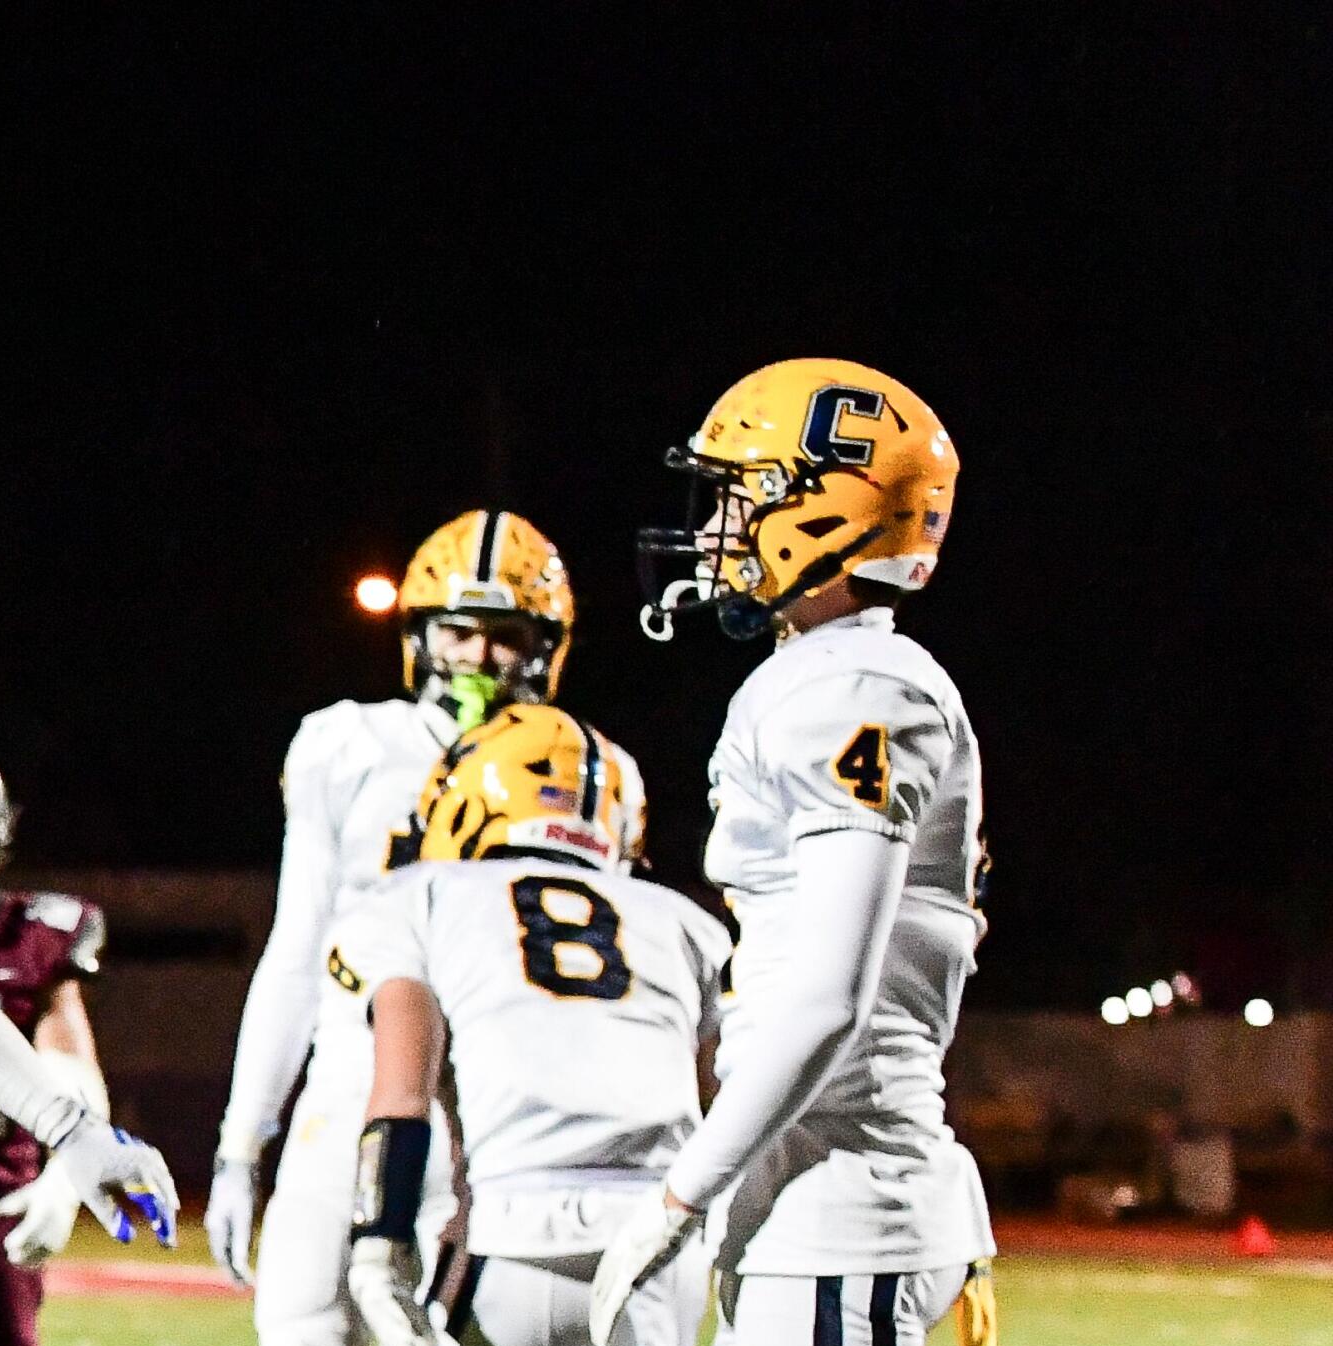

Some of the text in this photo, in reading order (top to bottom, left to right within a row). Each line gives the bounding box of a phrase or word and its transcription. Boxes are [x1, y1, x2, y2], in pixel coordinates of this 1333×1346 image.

[799, 383, 885, 468] C
[831, 721, 890, 811] 4
[327, 945, 367, 995] 8
[509, 874, 634, 1001] 8
